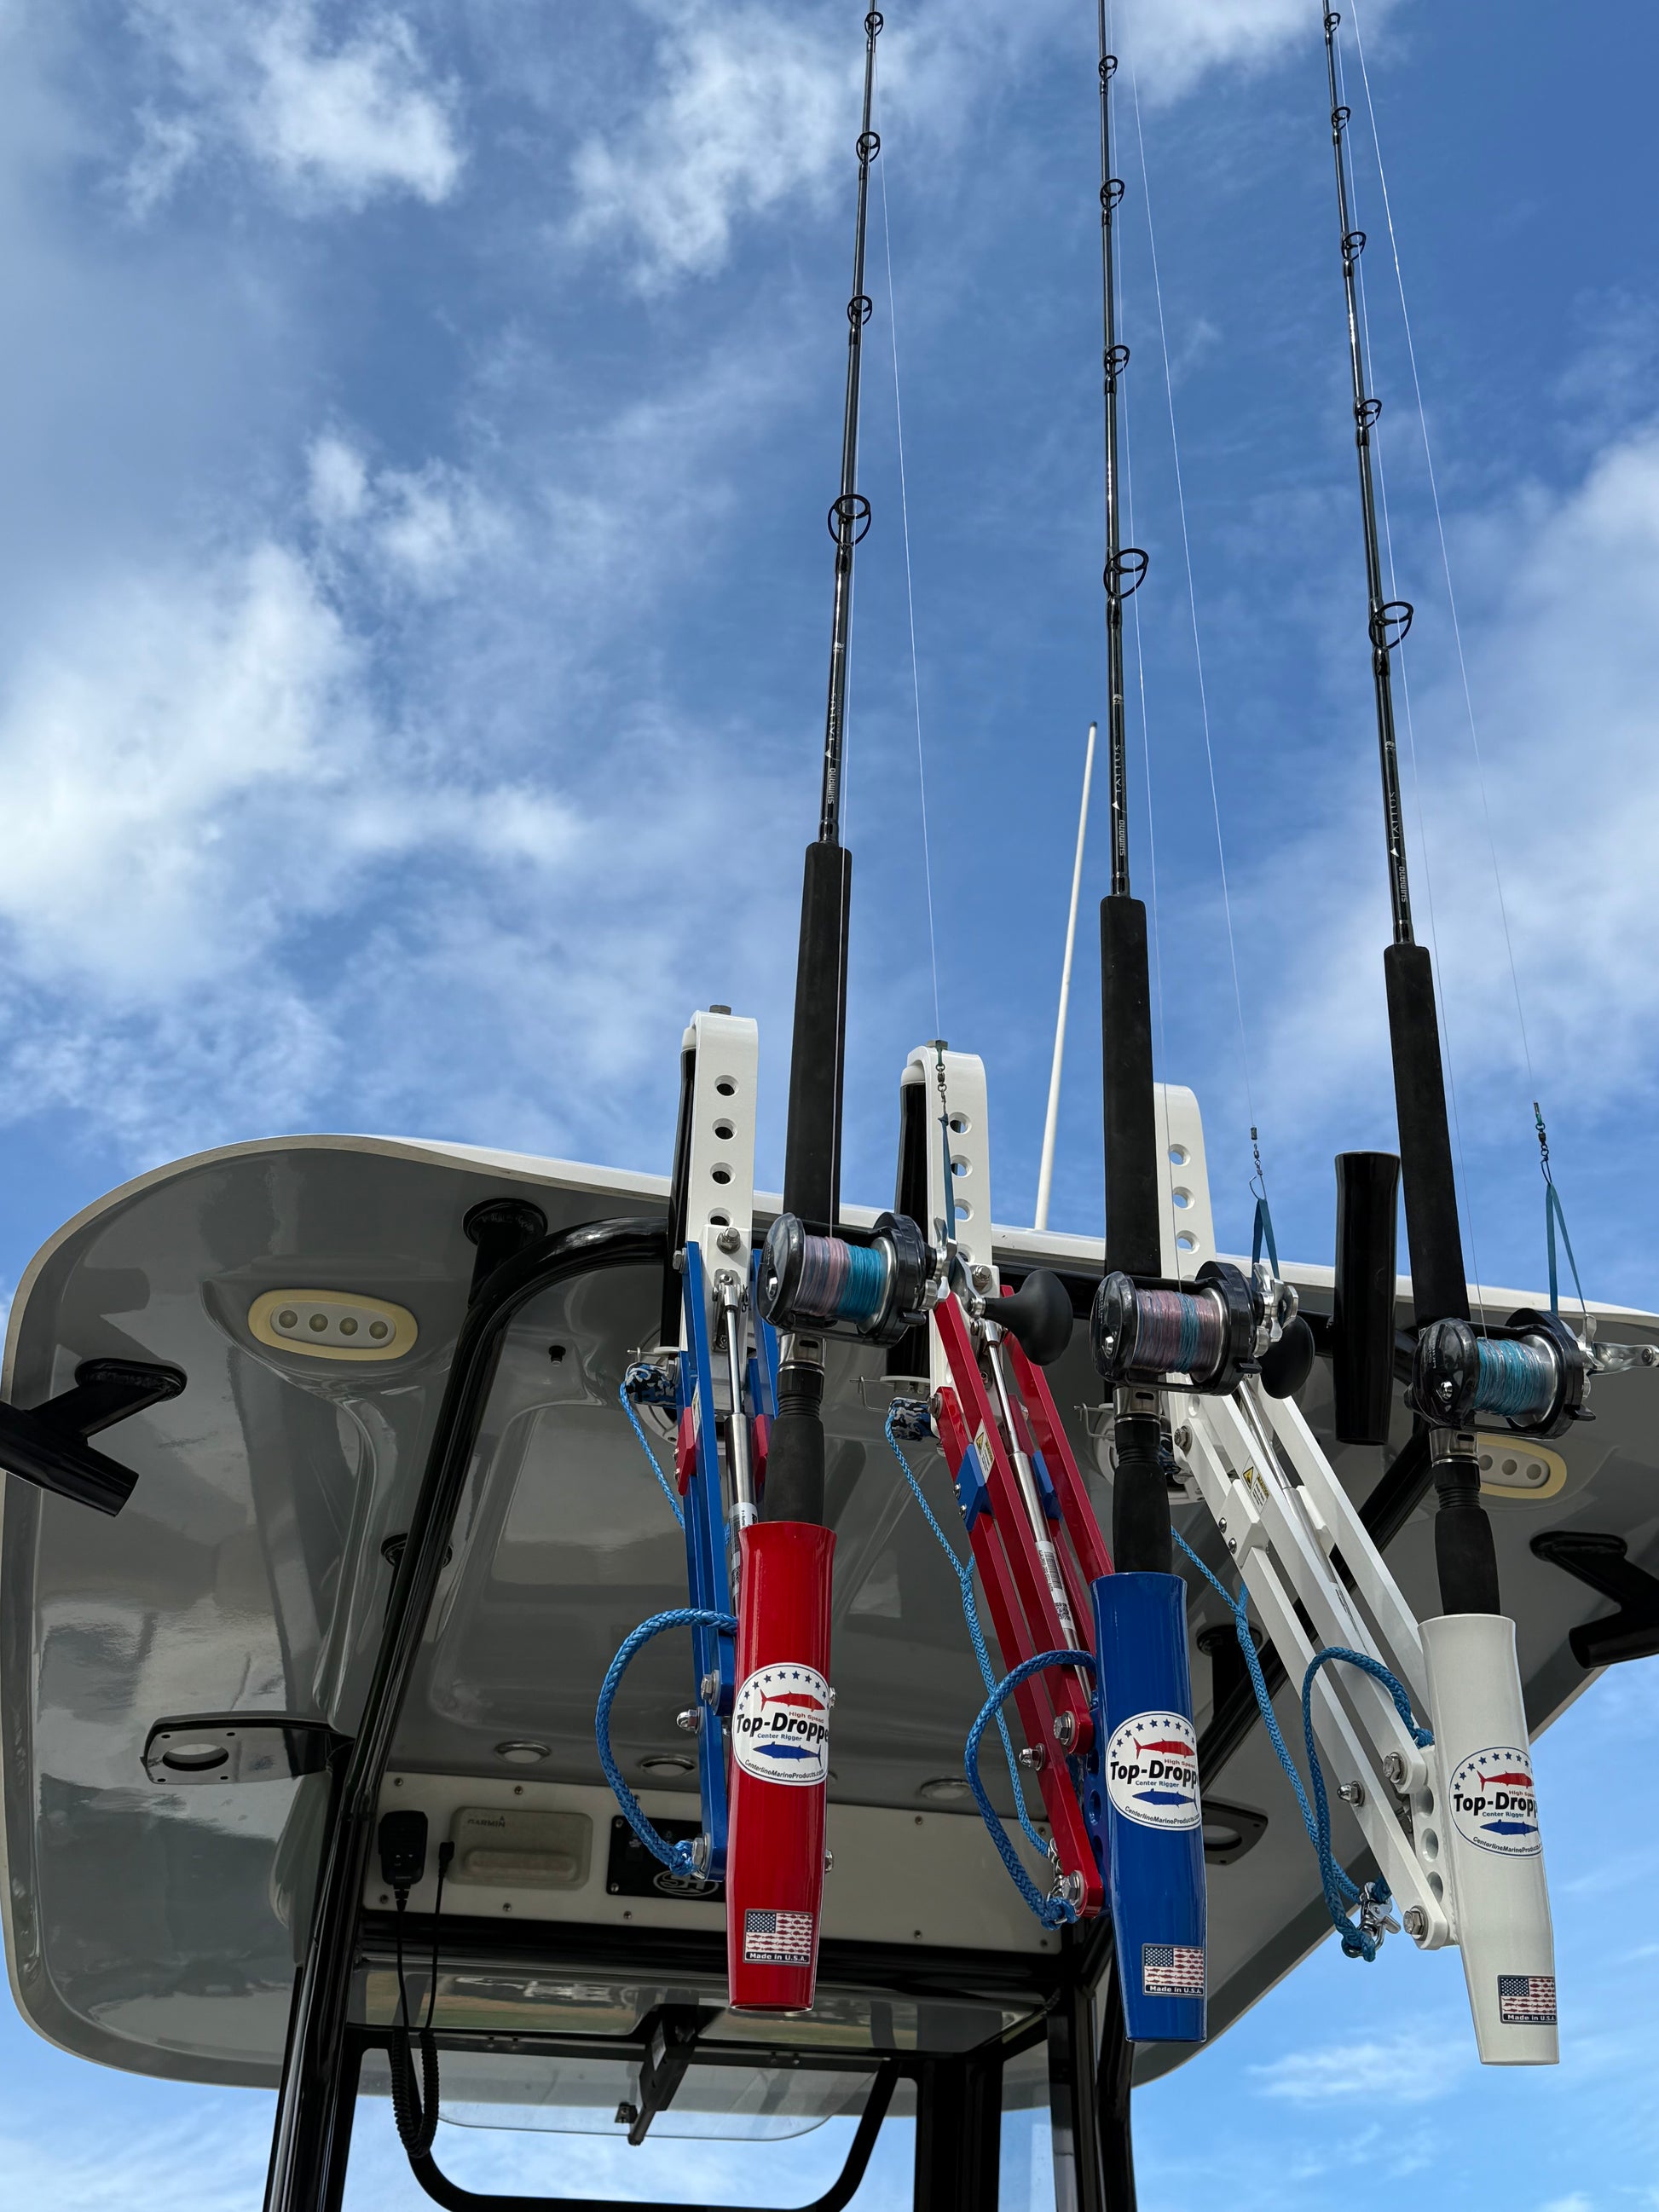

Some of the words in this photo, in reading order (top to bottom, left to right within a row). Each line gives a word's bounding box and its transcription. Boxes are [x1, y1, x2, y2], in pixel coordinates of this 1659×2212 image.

[828, 767, 836, 805] SHIMANO
[1398, 865, 1408, 903] SHIMANO
[780, 1733, 802, 1741] Rigger
[1110, 1760, 1197, 1789] Top-Dropp
[1159, 1780, 1180, 1788] Rigger
